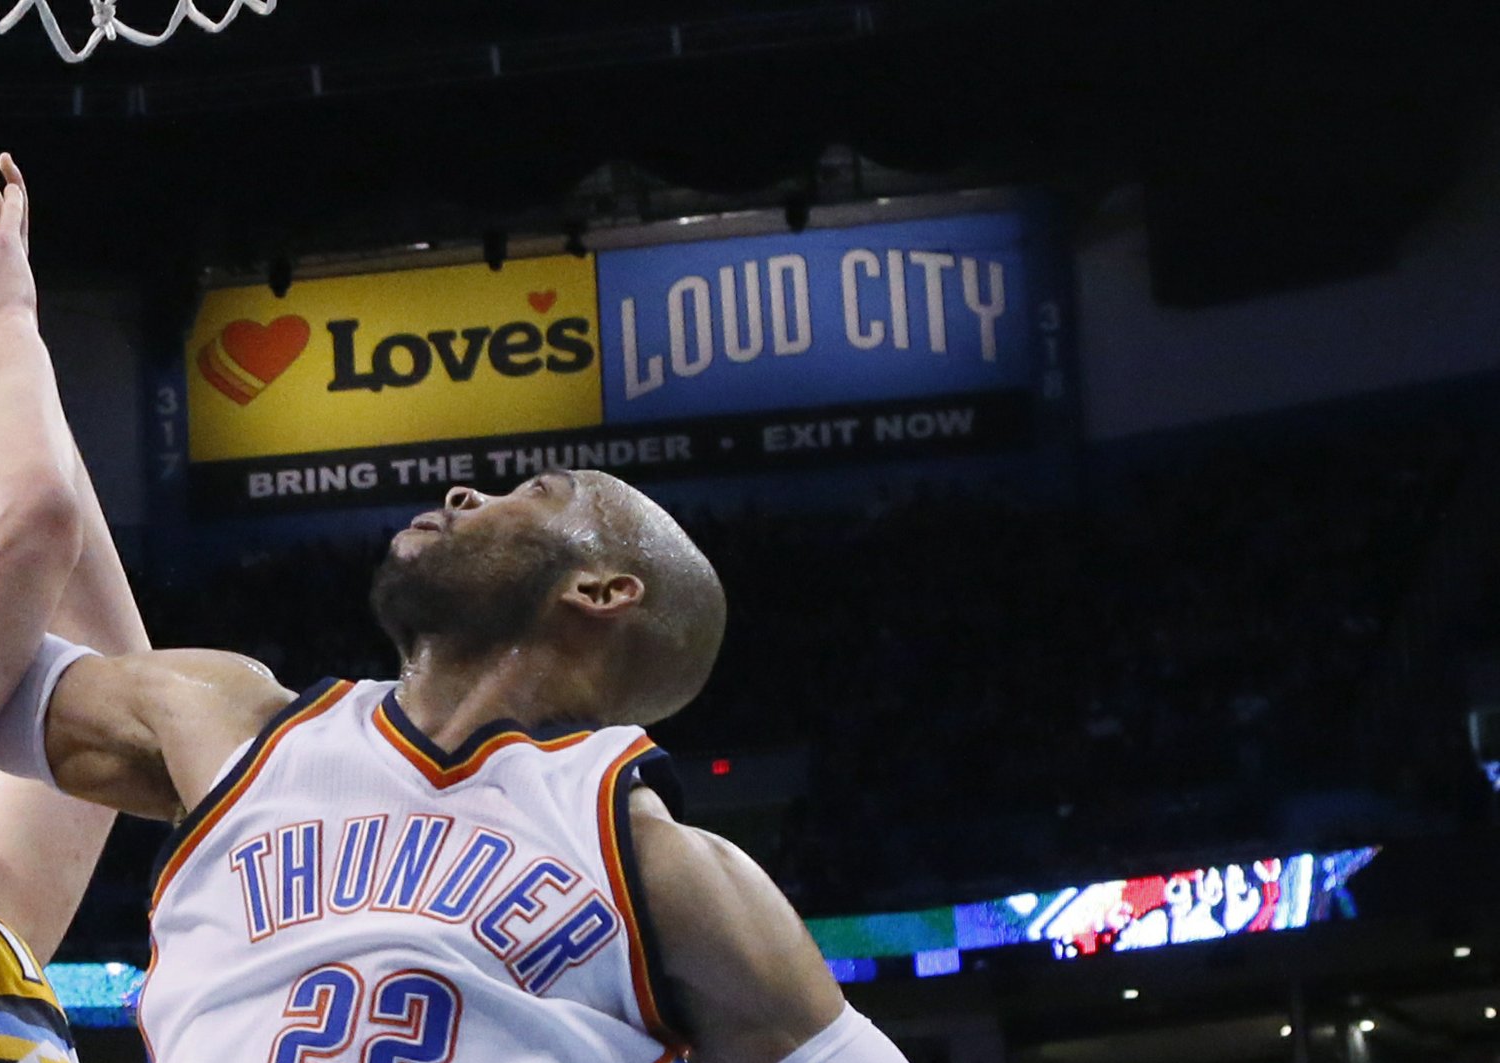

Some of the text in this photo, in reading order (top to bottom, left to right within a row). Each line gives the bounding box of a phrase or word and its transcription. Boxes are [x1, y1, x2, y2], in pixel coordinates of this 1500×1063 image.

[619, 248, 1006, 400] LOUD CITY
[248, 409, 975, 499] BRING THE THUNDER EXIT NOW
[229, 813, 620, 998] THUNDER
